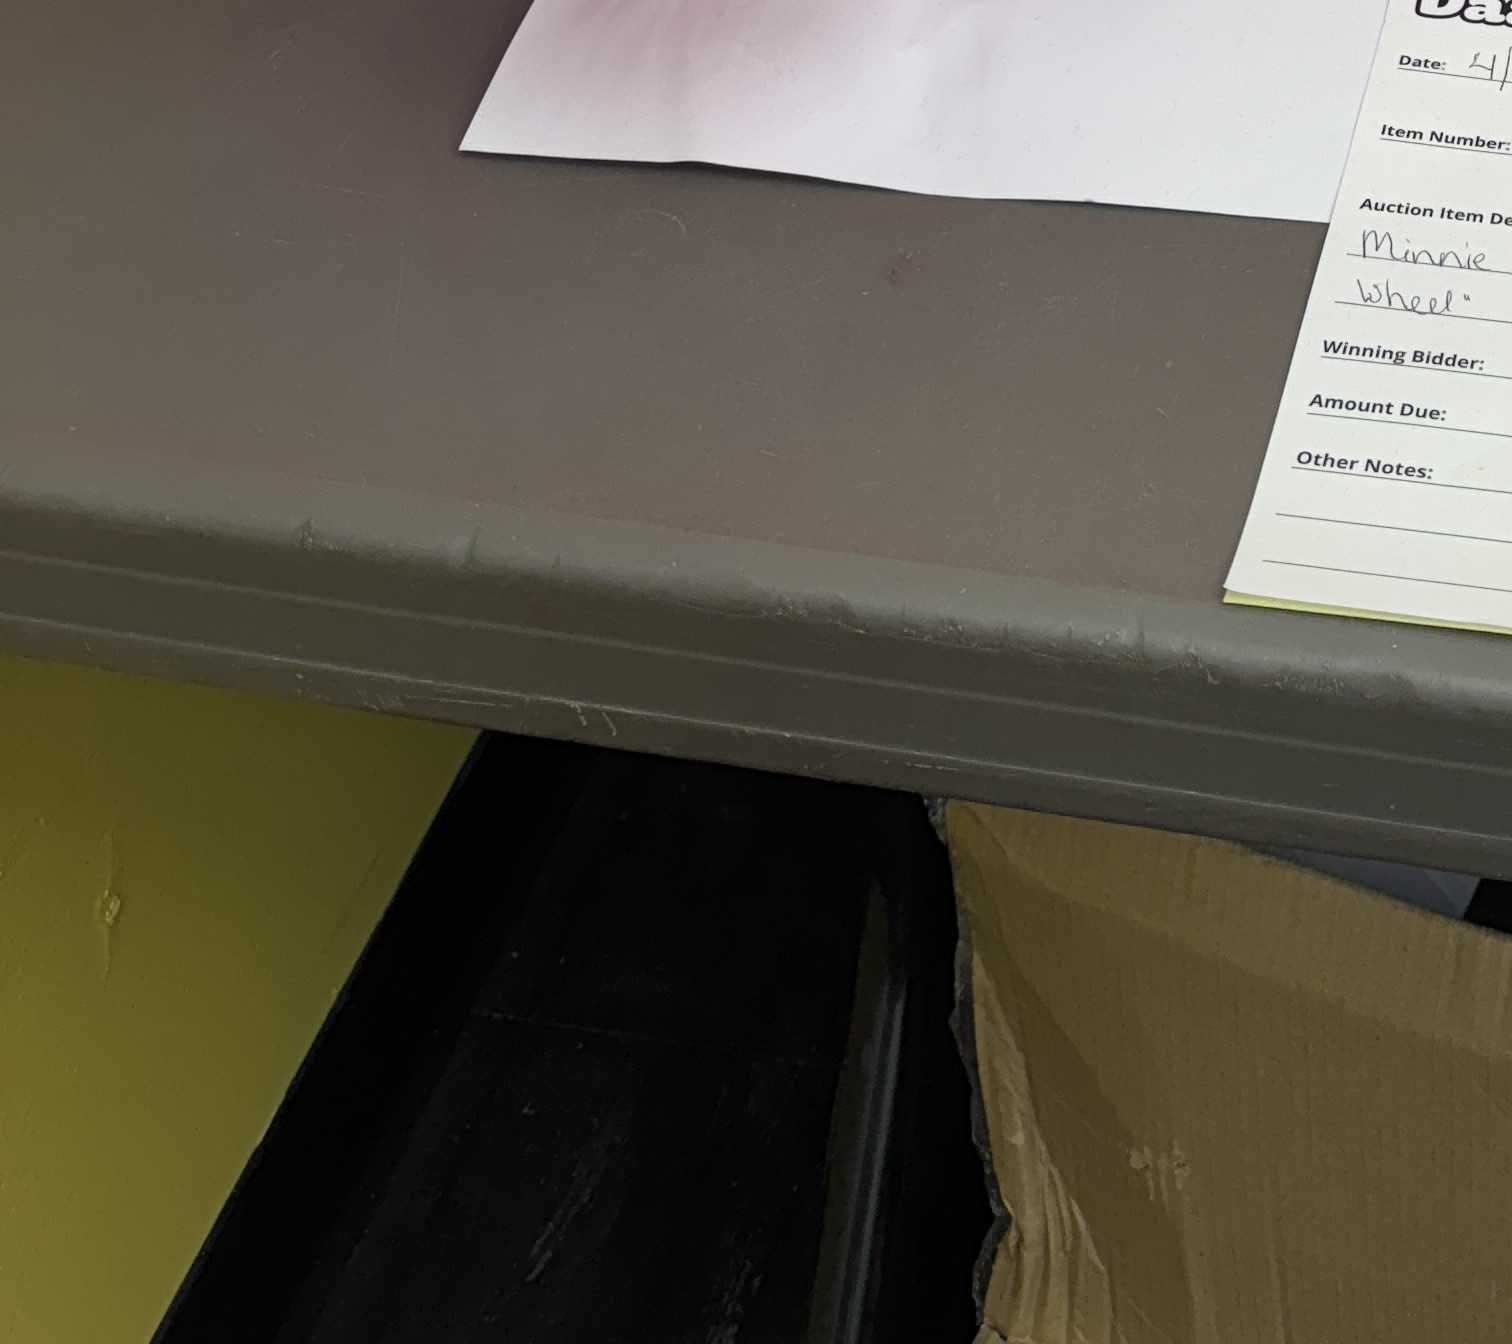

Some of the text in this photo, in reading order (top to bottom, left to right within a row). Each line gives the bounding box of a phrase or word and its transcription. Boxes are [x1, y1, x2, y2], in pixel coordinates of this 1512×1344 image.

[1398, 54, 1447, 71] Date:
[1380, 123, 1512, 152] Item Number:
[1359, 196, 1435, 219] Auction
[1439, 206, 1484, 225] Item
[1361, 228, 1492, 272] Minnie
[1322, 339, 1485, 371] Winning Bidder:
[1308, 392, 1448, 422] Amount Due:
[1296, 449, 1434, 481] Other Notes:
